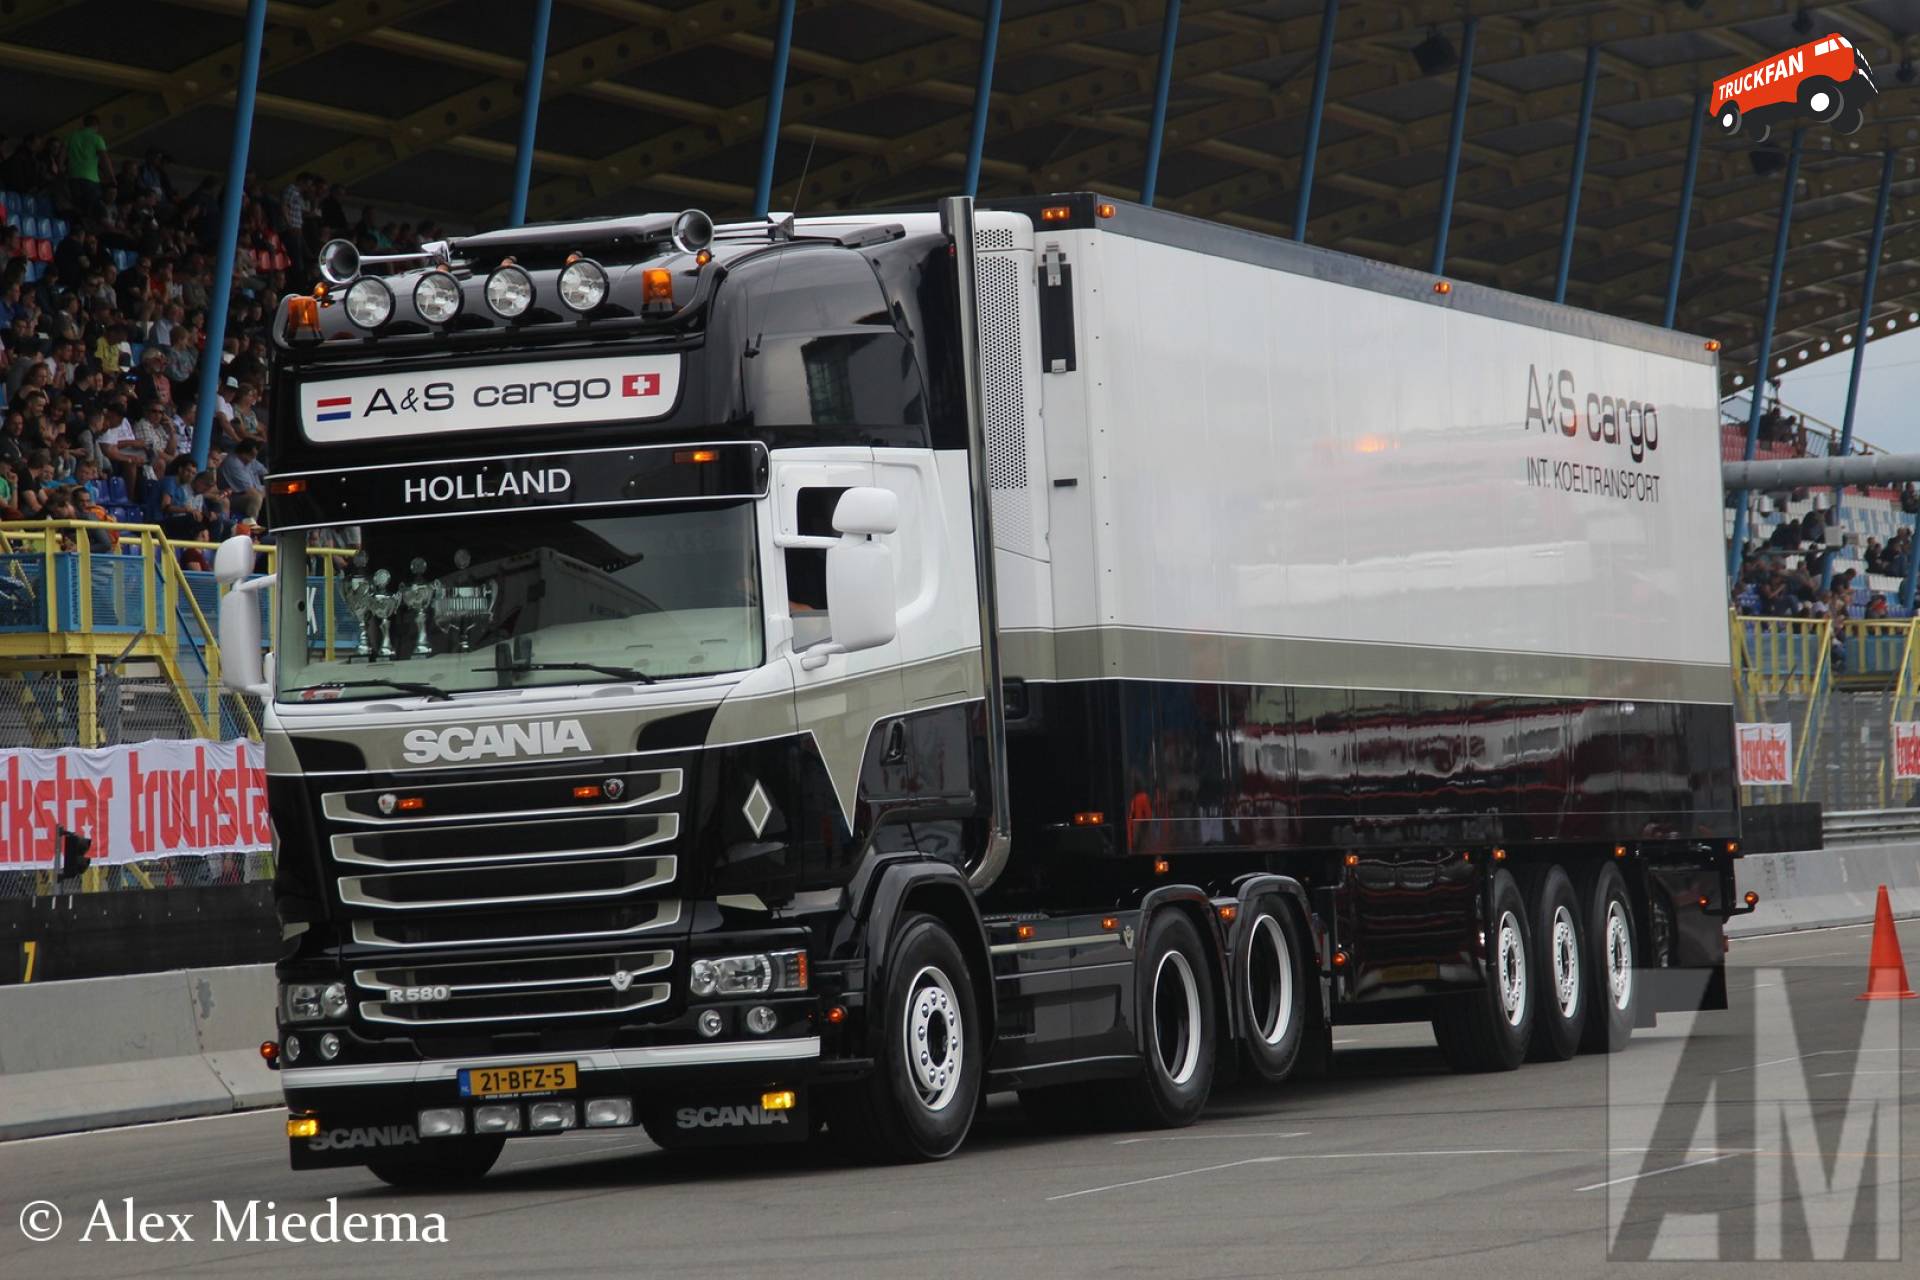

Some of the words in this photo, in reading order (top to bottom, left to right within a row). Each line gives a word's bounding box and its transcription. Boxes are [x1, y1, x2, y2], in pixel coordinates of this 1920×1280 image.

[363, 382, 454, 417] A&S
[473, 376, 611, 408] cargo
[1525, 364, 1577, 437] A&S
[1587, 392, 1658, 463] cargo
[404, 468, 571, 503] HOLLAND
[1527, 456, 1550, 488] INT.
[1554, 460, 1660, 503] KOELTRANSPORT
[403, 719, 592, 764] SCANIA
[480, 1068, 566, 1092] 21-BFZ-5
[676, 1105, 789, 1129] SCANIA
[308, 1125, 419, 1151] SCANIA
